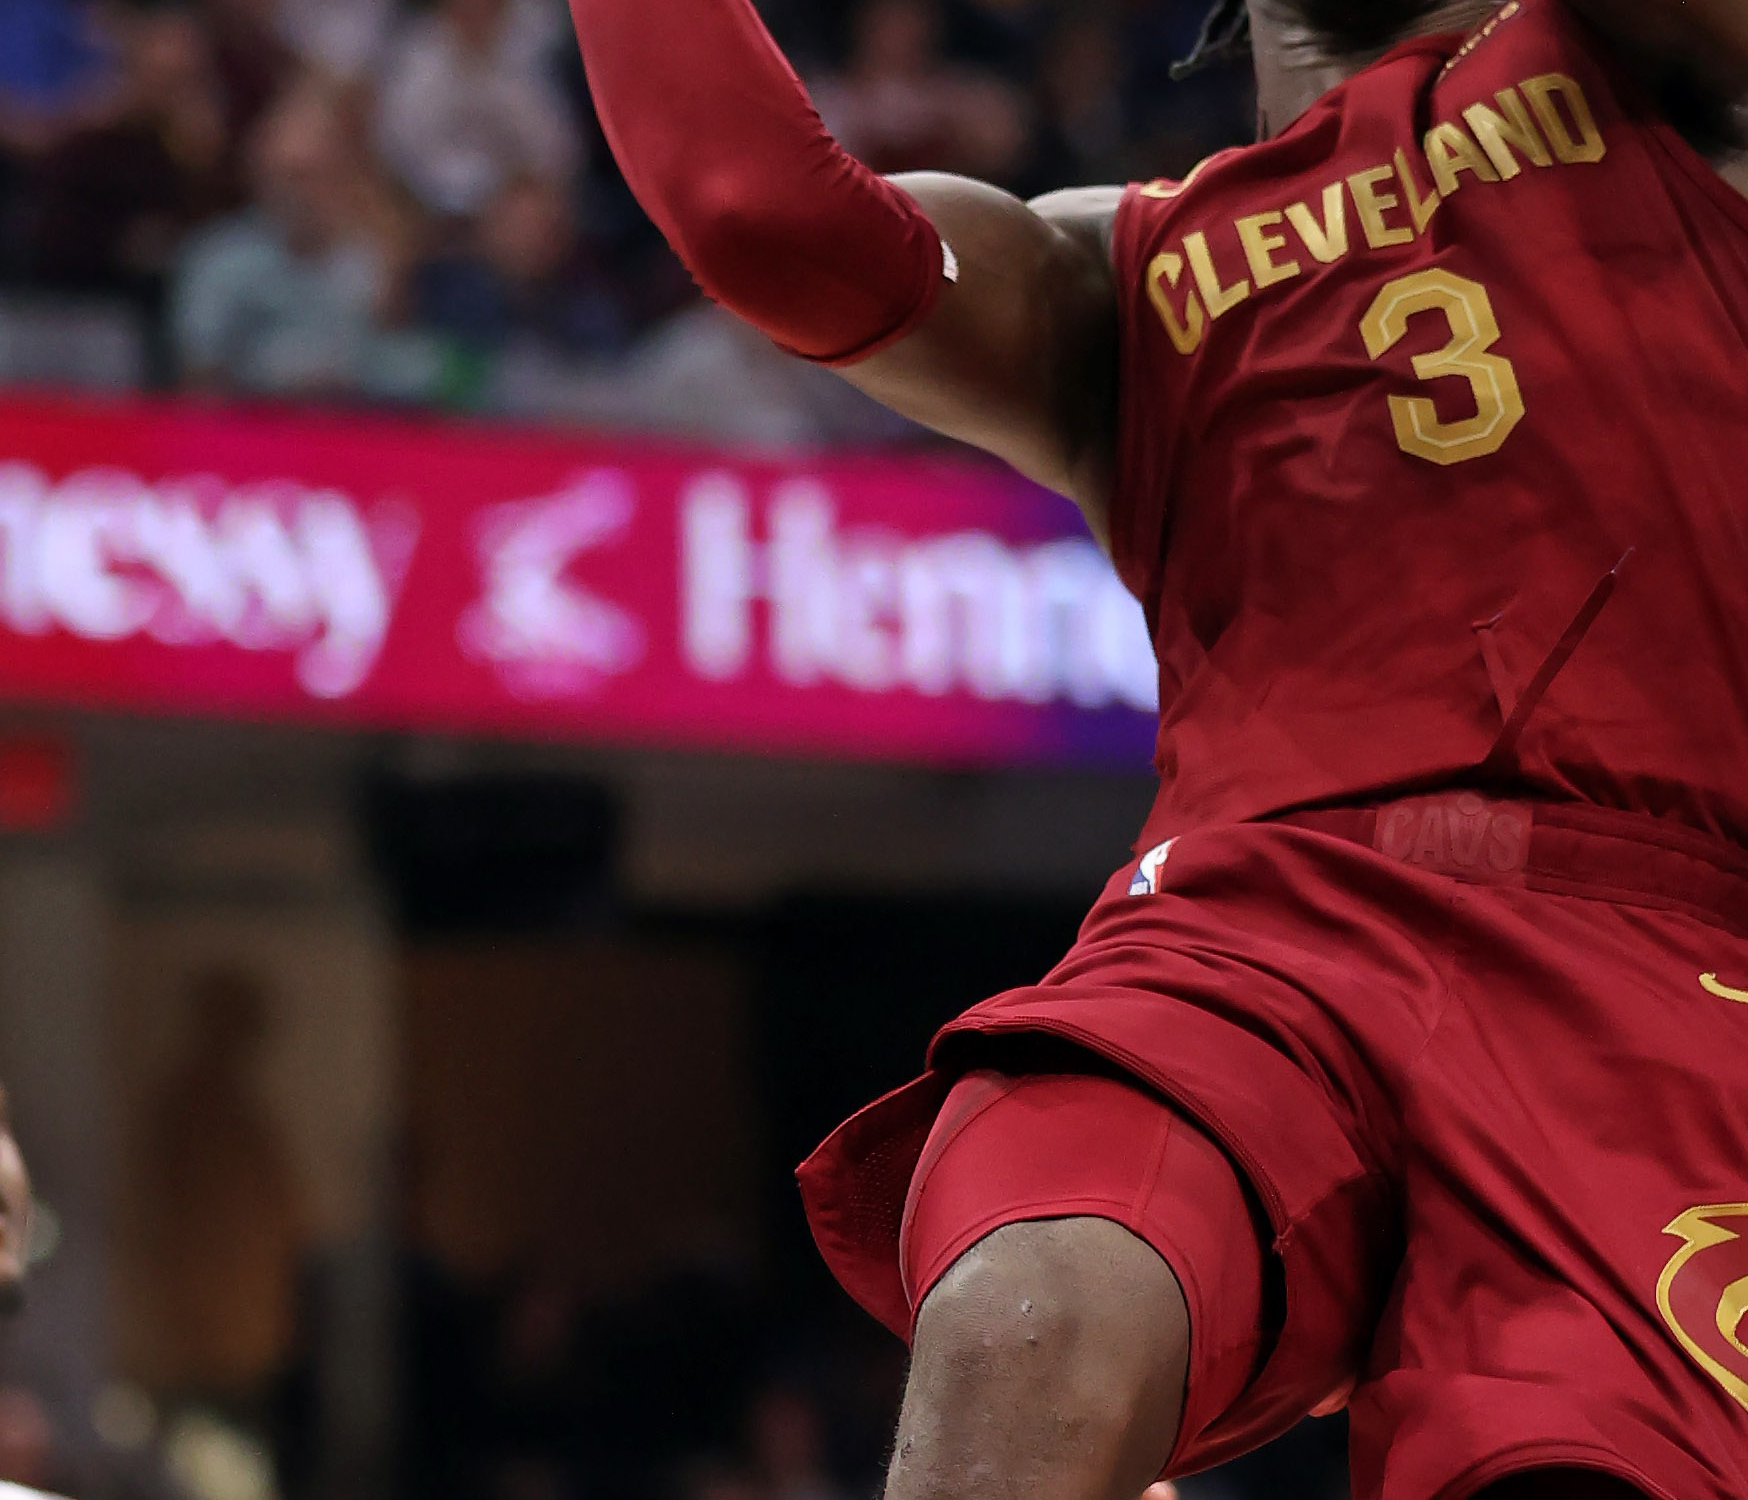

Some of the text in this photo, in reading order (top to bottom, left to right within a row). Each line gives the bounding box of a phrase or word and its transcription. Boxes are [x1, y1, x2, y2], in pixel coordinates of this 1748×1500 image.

[1146, 72, 1607, 356] CLEVELAND
[1358, 267, 1526, 467] 3
[682, 468, 1158, 714] Henn
